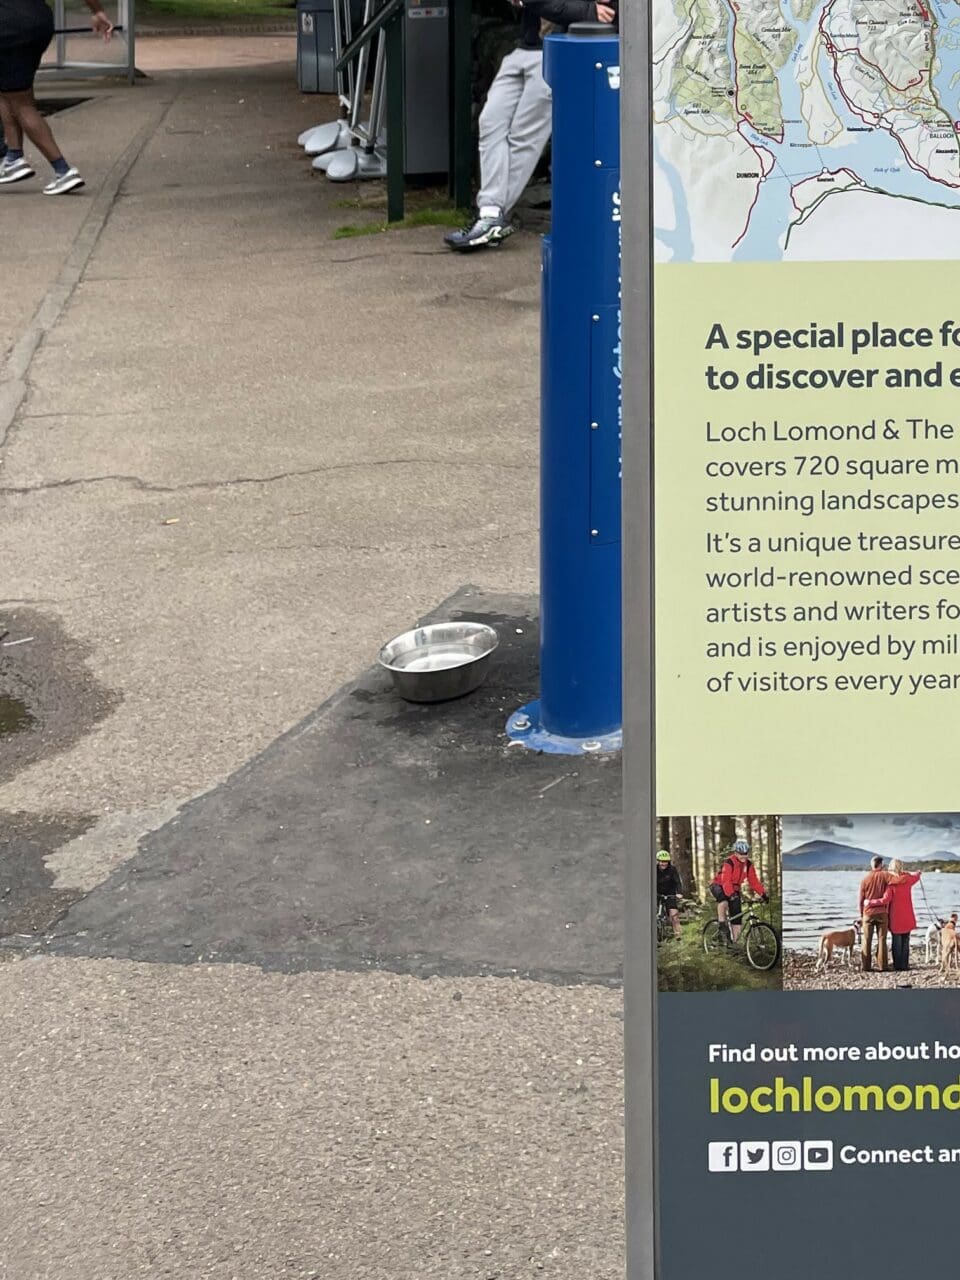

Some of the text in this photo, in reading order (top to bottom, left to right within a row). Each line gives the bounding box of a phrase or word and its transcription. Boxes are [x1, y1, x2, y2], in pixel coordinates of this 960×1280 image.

[705, 324, 729, 349] A
[736, 322, 843, 355] special
[852, 322, 933, 354] place
[705, 366, 739, 390] to
[746, 364, 879, 389] discover
[886, 362, 942, 387] and
[707, 421, 765, 441] Loch
[774, 420, 875, 440] Lomond
[883, 419, 899, 439] &
[906, 419, 953, 439] The
[706, 461, 786, 476] covers
[794, 456, 839, 475] 720
[847, 460, 929, 480] square
[707, 491, 813, 516] stunning
[708, 533, 741, 552] It's
[749, 538, 760, 552] a
[769, 532, 851, 557] unique
[858, 532, 960, 551] treasure
[706, 565, 911, 587] world-renowned
[707, 603, 786, 622] artists
[794, 601, 837, 621] and
[844, 601, 929, 620] writers
[707, 637, 750, 657] and
[759, 637, 776, 656] is
[784, 635, 880, 661] enjoyed
[888, 635, 915, 660] by
[707, 672, 732, 692] of
[738, 672, 828, 692] visitors
[835, 675, 902, 695] every
[710, 1044, 755, 1062] Find
[761, 1044, 798, 1061] out
[804, 1047, 860, 1060] more
[865, 1042, 929, 1060] about
[841, 1146, 934, 1163] Connect
